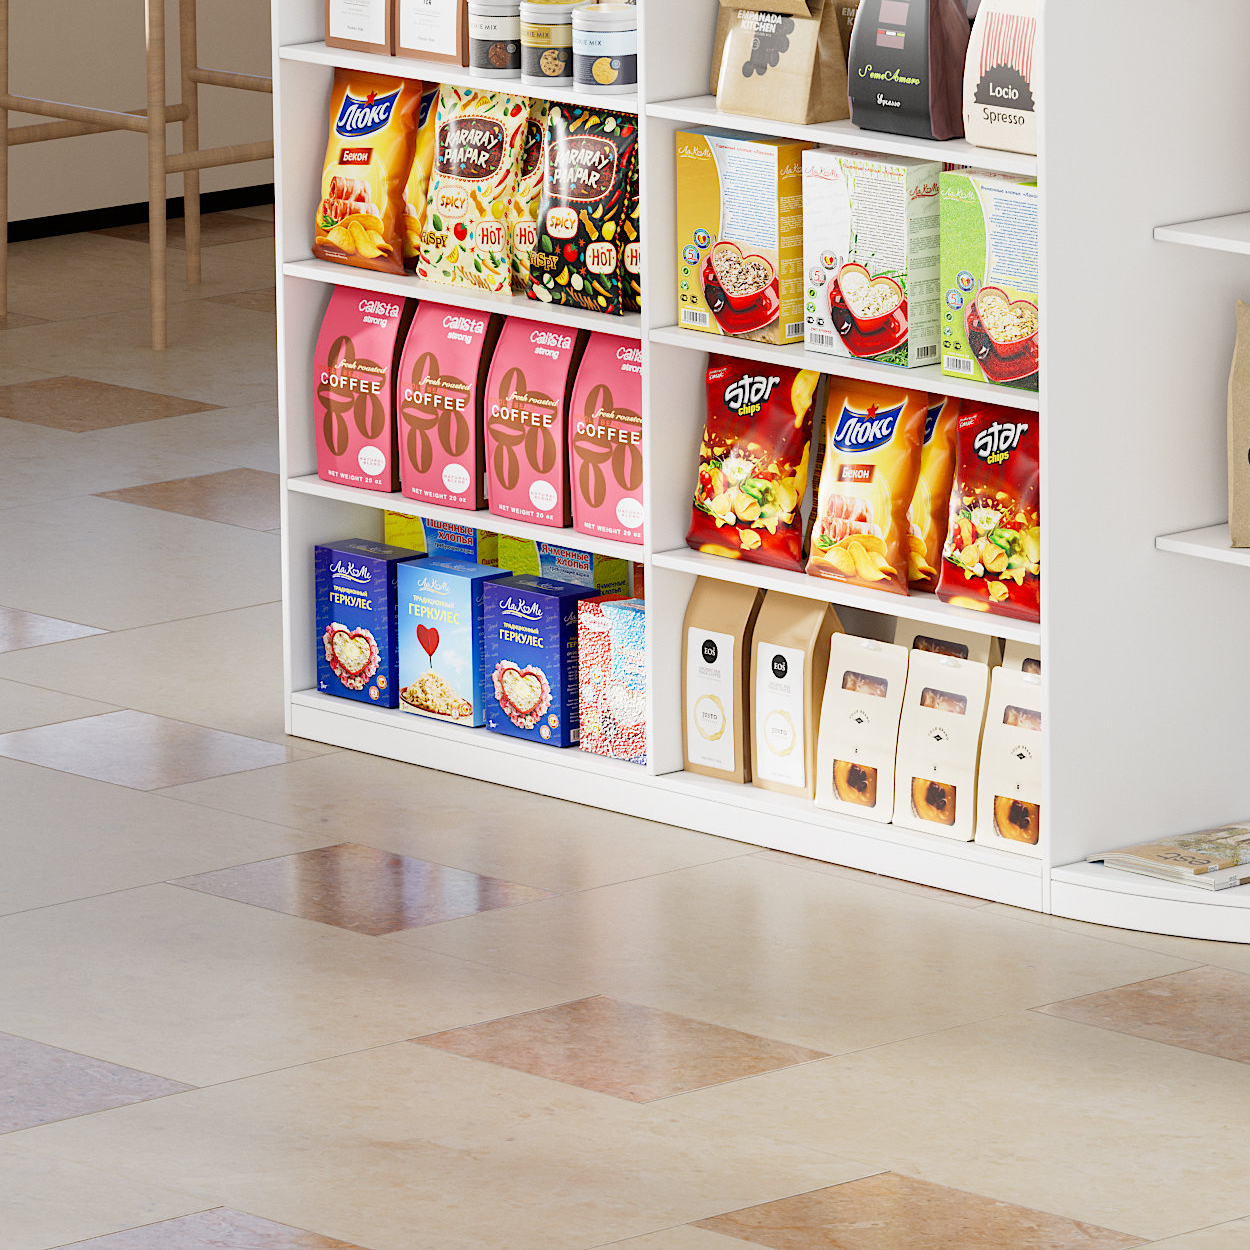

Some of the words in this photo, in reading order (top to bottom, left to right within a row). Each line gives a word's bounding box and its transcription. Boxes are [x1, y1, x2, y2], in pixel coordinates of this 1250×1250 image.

[737, 10, 782, 24] EMPANADA
[485, 23, 498, 31] MIX
[741, 20, 776, 33] KITCHEN
[989, 83, 1019, 100] Locio
[983, 107, 1025, 126] Spresso
[445, 128, 499, 150] KARARAY
[343, 150, 368, 161] Бекон
[440, 194, 466, 210] SPICY
[549, 214, 576, 230] SPICY
[362, 315, 388, 328] strong
[447, 331, 472, 345] strong
[534, 347, 559, 360] strong
[335, 359, 357, 371] fresh
[357, 362, 388, 374] roasted
[320, 372, 381, 395] COFFEE
[419, 375, 441, 387] fresh
[441, 378, 473, 391] roasted
[405, 388, 465, 411] COFFEE
[491, 404, 552, 428] COFFEE
[738, 403, 761, 416] chips
[577, 421, 640, 445] COFFEE
[987, 450, 1010, 464] chips
[328, 469, 339, 478] NET
[339, 471, 363, 483] WEIGHT
[842, 466, 869, 479] Бекон
[541, 544, 590, 562] Ячменные
[330, 592, 372, 611] ГЕРКУЛЕС
[408, 603, 460, 625] ГЕРКУЛЕС
[499, 629, 544, 649] ГЕРКУЛЕС
